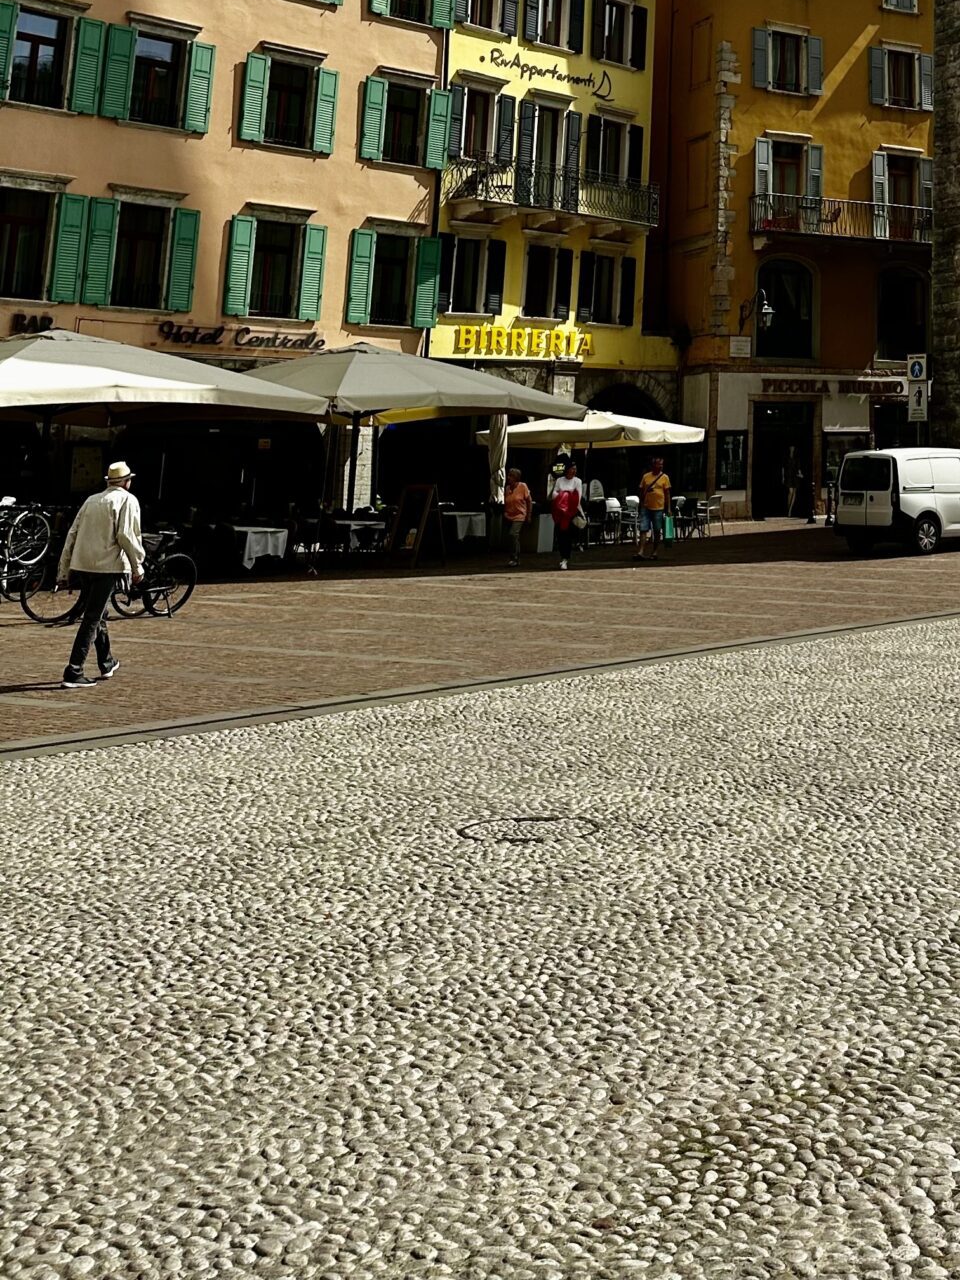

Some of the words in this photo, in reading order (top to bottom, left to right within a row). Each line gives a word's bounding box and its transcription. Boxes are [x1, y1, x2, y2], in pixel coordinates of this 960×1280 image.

[490, 47, 596, 89] RivAppartamenti
[11, 313, 54, 333] BAR
[159, 320, 225, 347] Hotel
[234, 326, 326, 352] Centrale
[457, 324, 596, 356] BIRRERIA
[761, 378, 831, 394] PICCOLA
[838, 380, 904, 394] MURANO
